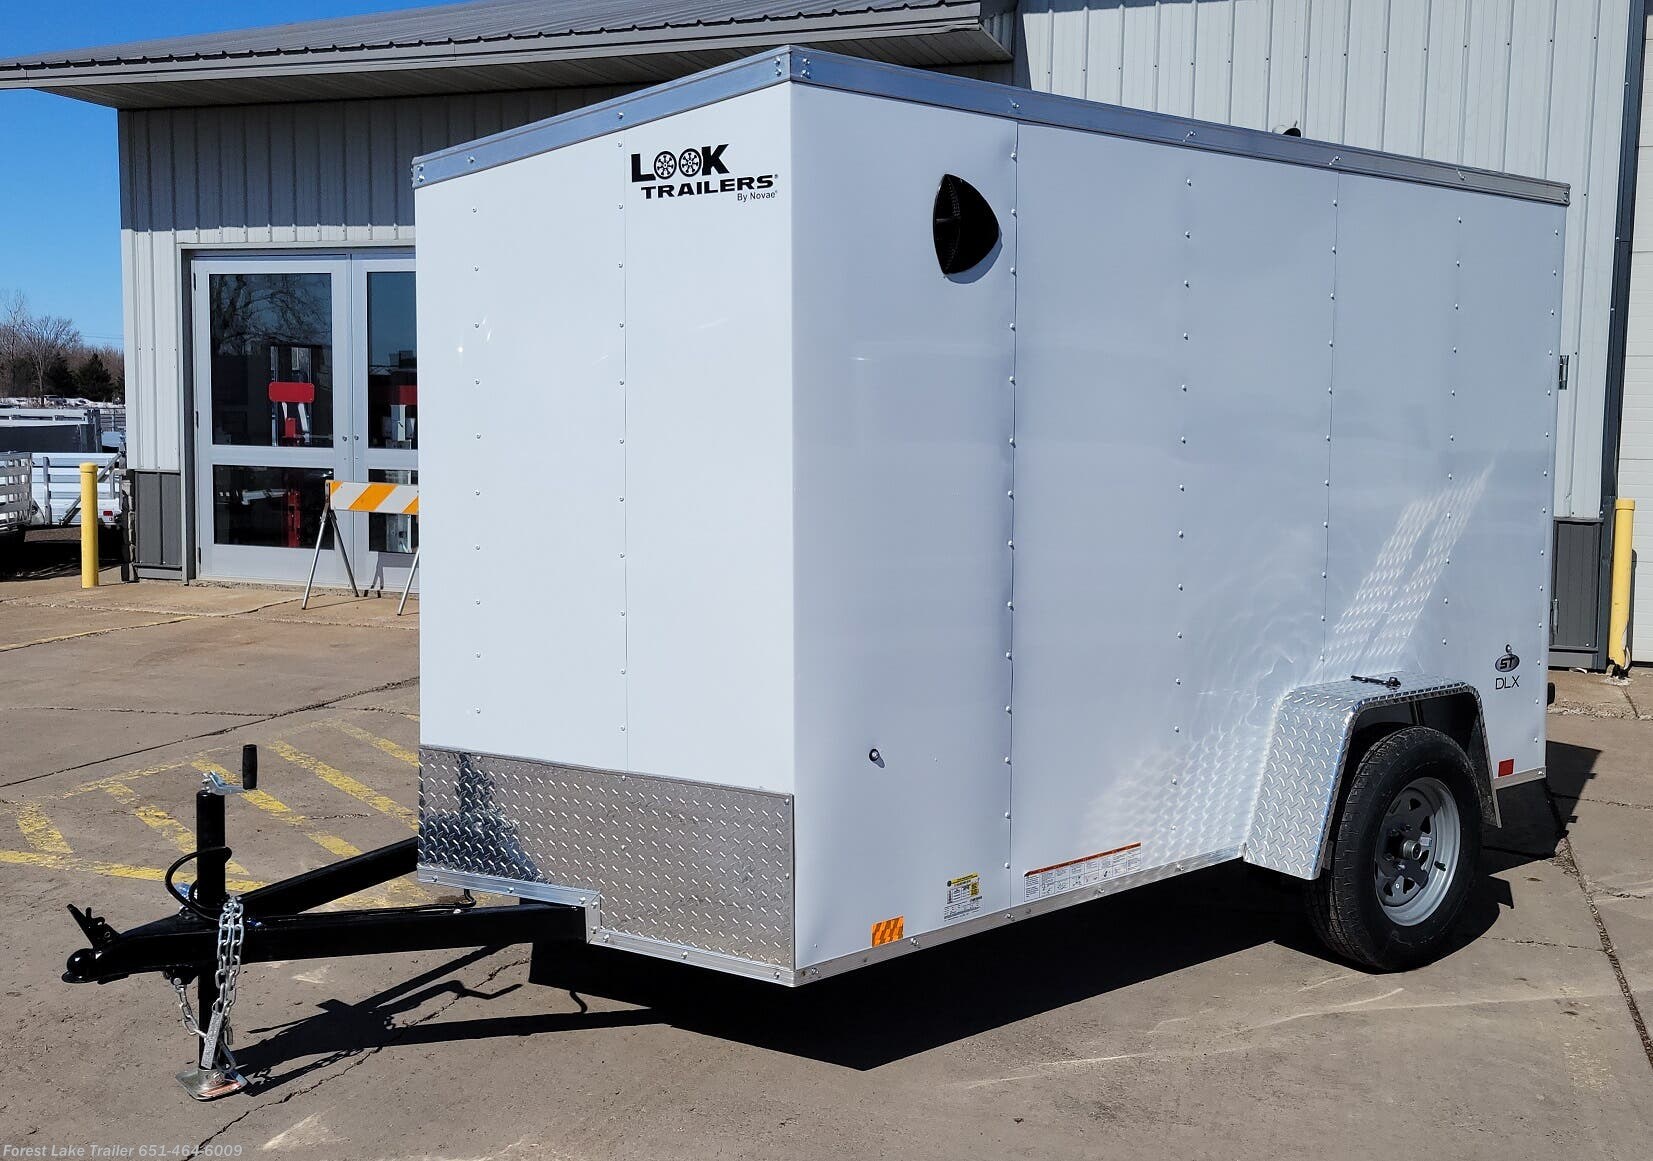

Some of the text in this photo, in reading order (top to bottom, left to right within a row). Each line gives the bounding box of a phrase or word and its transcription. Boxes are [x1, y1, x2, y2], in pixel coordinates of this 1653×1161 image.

[631, 144, 730, 183] LOOK
[737, 193, 748, 202] By
[1500, 657, 1515, 669] ST
[1496, 675, 1520, 690] DLX
